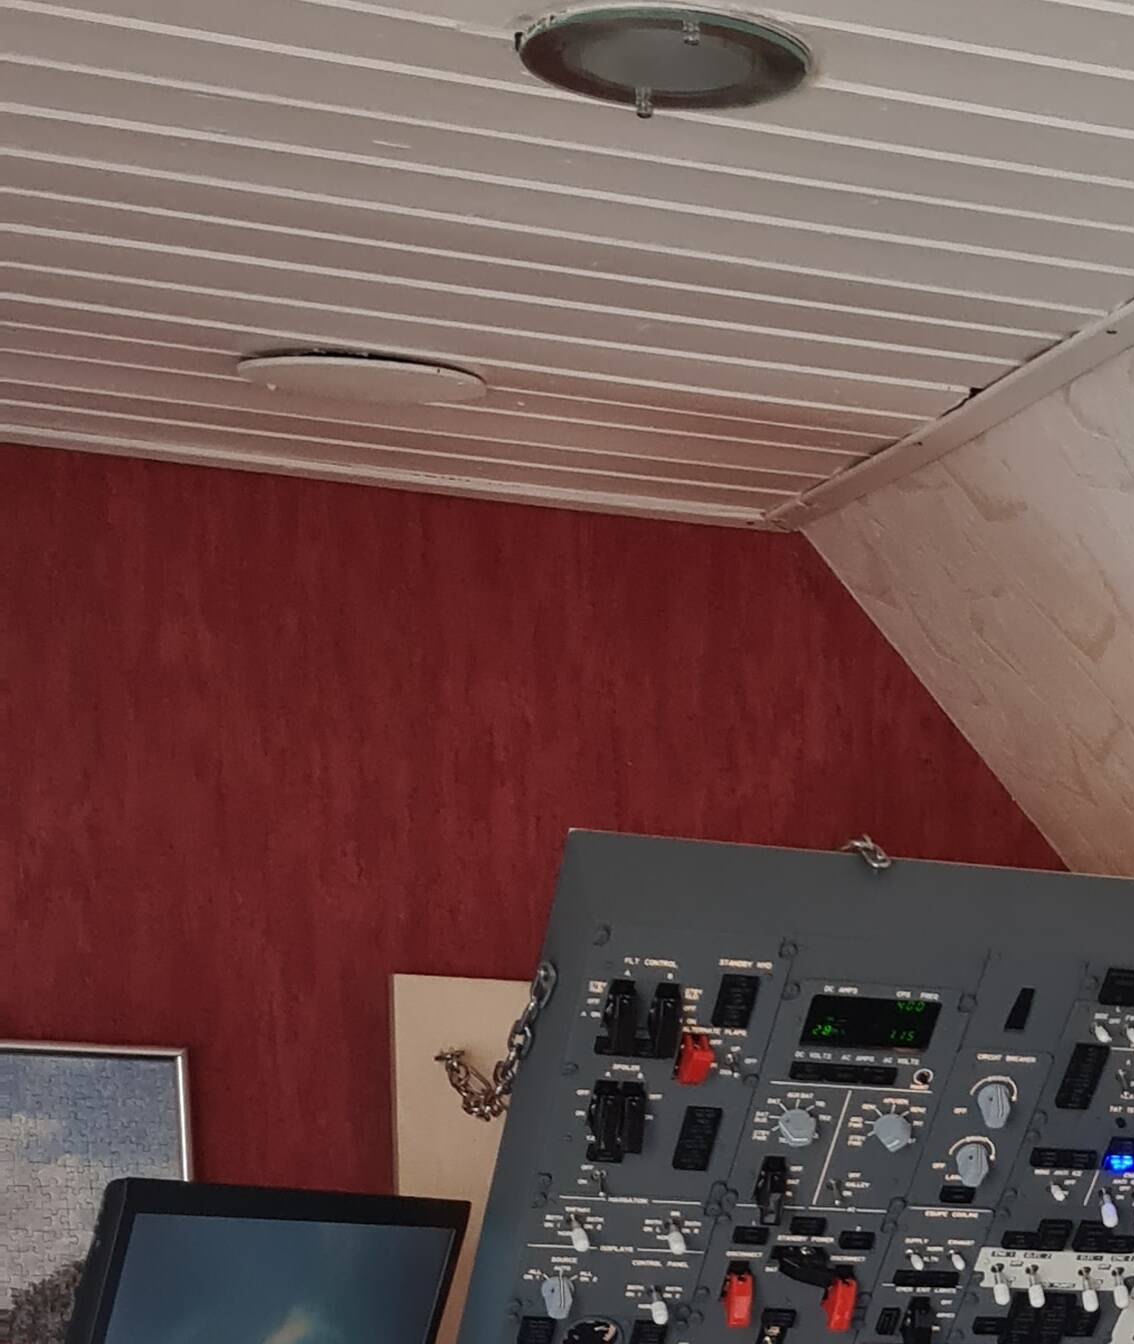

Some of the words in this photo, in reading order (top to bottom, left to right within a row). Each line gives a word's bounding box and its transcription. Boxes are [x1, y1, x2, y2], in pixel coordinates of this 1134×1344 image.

[644, 958, 678, 968] CONTROL
[838, 986, 859, 995] AMPS
[809, 1052, 832, 1060] VOLTS
[632, 1259, 662, 1267] CONTROL
